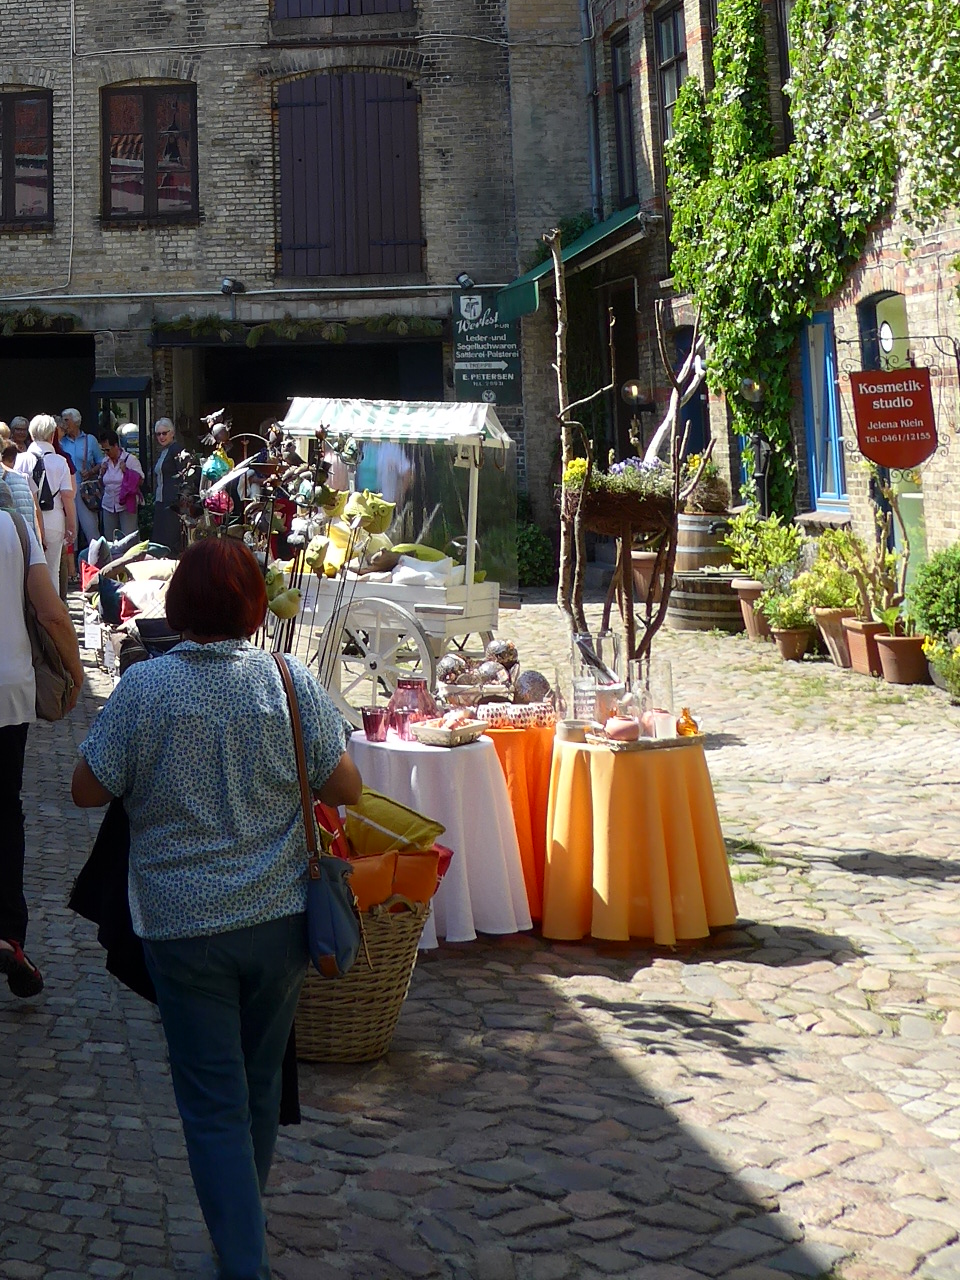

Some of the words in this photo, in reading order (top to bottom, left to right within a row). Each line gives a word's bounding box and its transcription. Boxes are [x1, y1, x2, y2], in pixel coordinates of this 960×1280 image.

[858, 380, 925, 395] Kosmetik-
[872, 396, 914, 410] studio
[867, 420, 899, 430] Jelena
[900, 419, 924, 429] Klein
[865, 435, 881, 443] Tel.
[881, 432, 931, 443] 0461/12155
